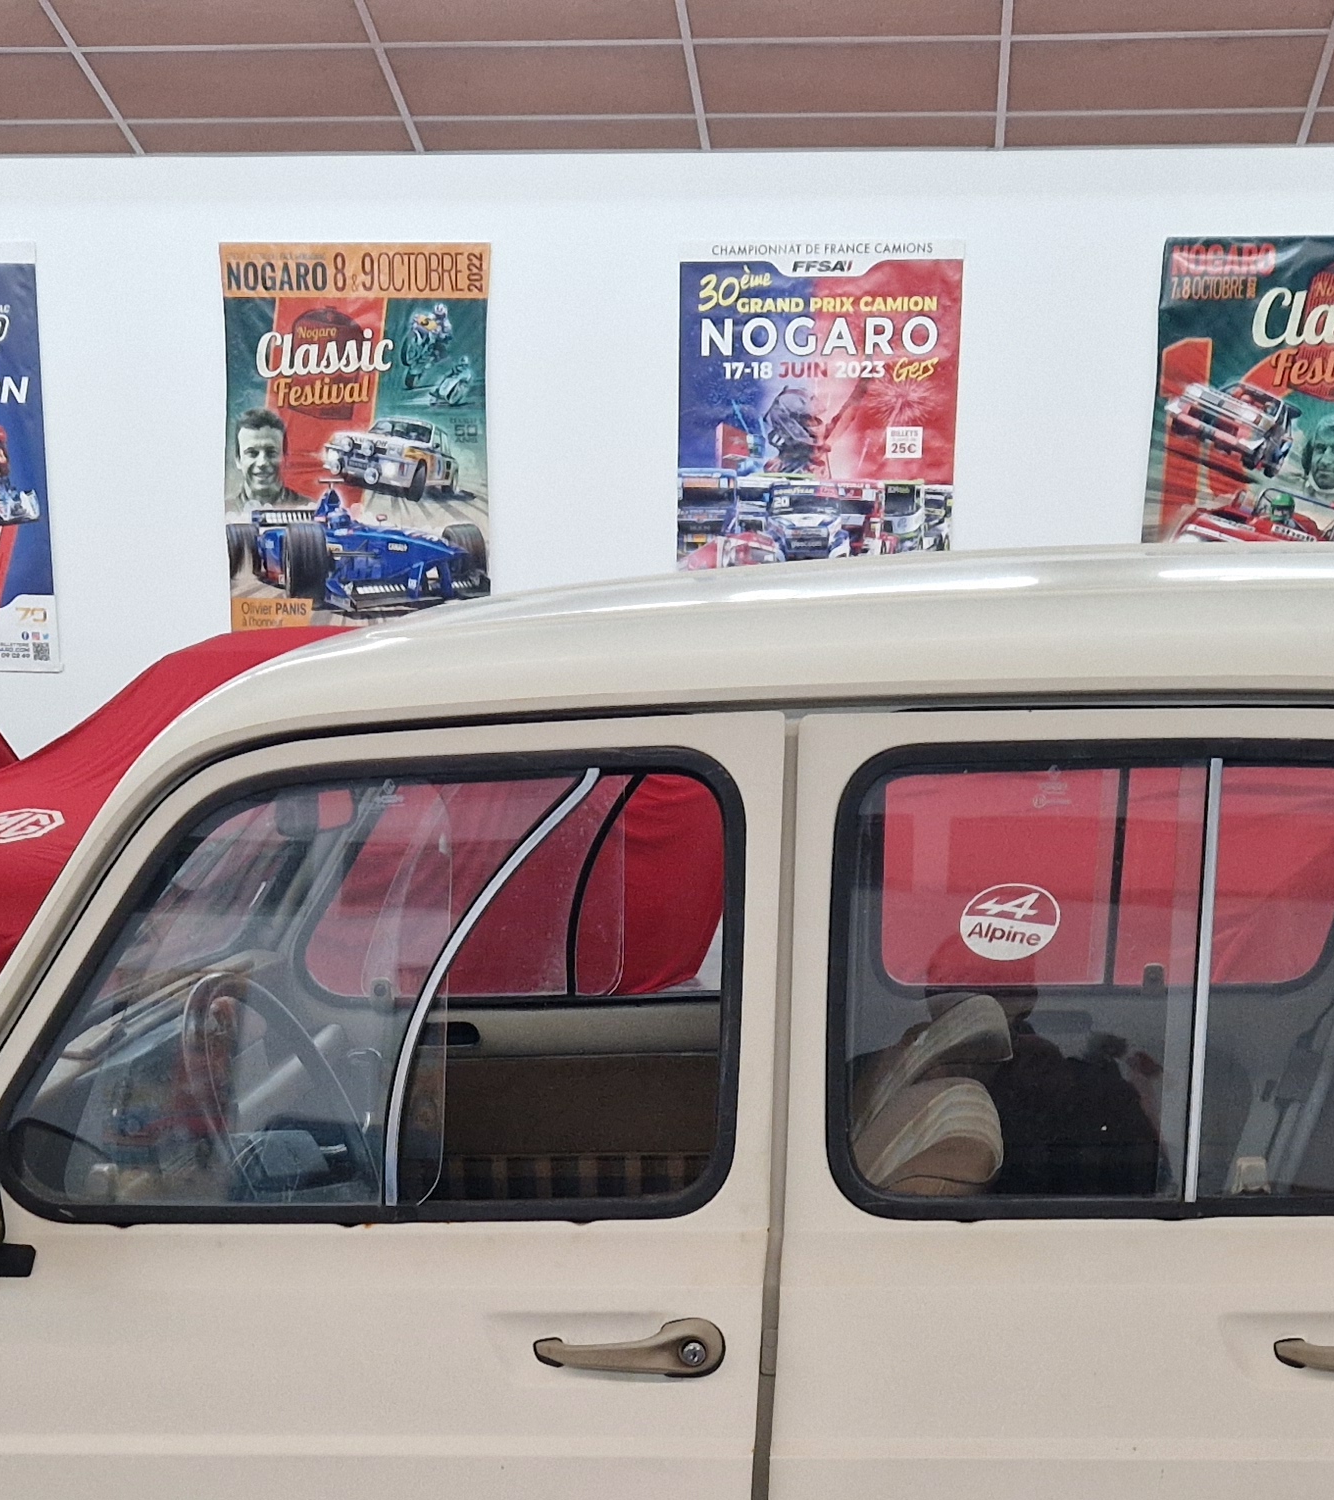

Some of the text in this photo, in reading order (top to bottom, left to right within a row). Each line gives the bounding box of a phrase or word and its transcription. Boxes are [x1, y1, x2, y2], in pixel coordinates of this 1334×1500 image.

[711, 242, 934, 256] CHAMPIONNAT DE FRANCE CAMIONS
[1171, 243, 1277, 277] NOGARO
[226, 261, 328, 292] NOGARO
[333, 252, 347, 292] 8
[361, 252, 375, 292] 9
[377, 252, 466, 293] OCTOBRE
[467, 252, 484, 293] 2022
[792, 260, 847, 273] FFSA
[1192, 276, 1246, 300] OCTOBRE
[737, 295, 938, 314] GRAND PRIX CAMION
[297, 326, 337, 341] Nogaro
[699, 316, 940, 357] NOGARO
[256, 328, 394, 378] Classic
[723, 357, 940, 383] 17-18 JUIN 2023 Gers
[273, 374, 371, 408] Festival
[455, 424, 478, 437] 50
[891, 443, 918, 454] 25€
[241, 602, 307, 616] Olivier PANIS
[967, 922, 1041, 946] Alpine
